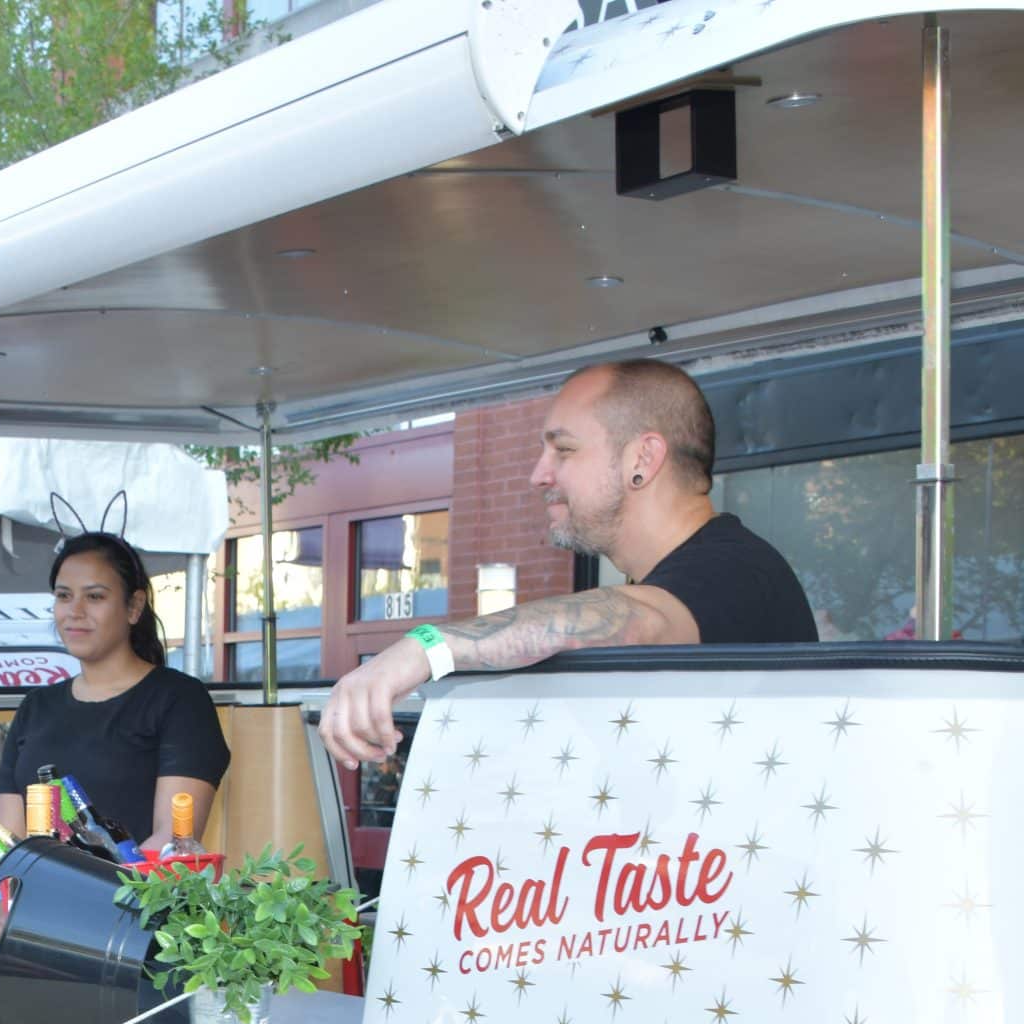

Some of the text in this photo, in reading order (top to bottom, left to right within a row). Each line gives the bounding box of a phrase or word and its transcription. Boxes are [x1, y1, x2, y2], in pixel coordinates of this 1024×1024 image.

[386, 593, 412, 618] 815
[446, 832, 734, 942] Real Taste
[459, 910, 730, 975] COMES NATURALLY
